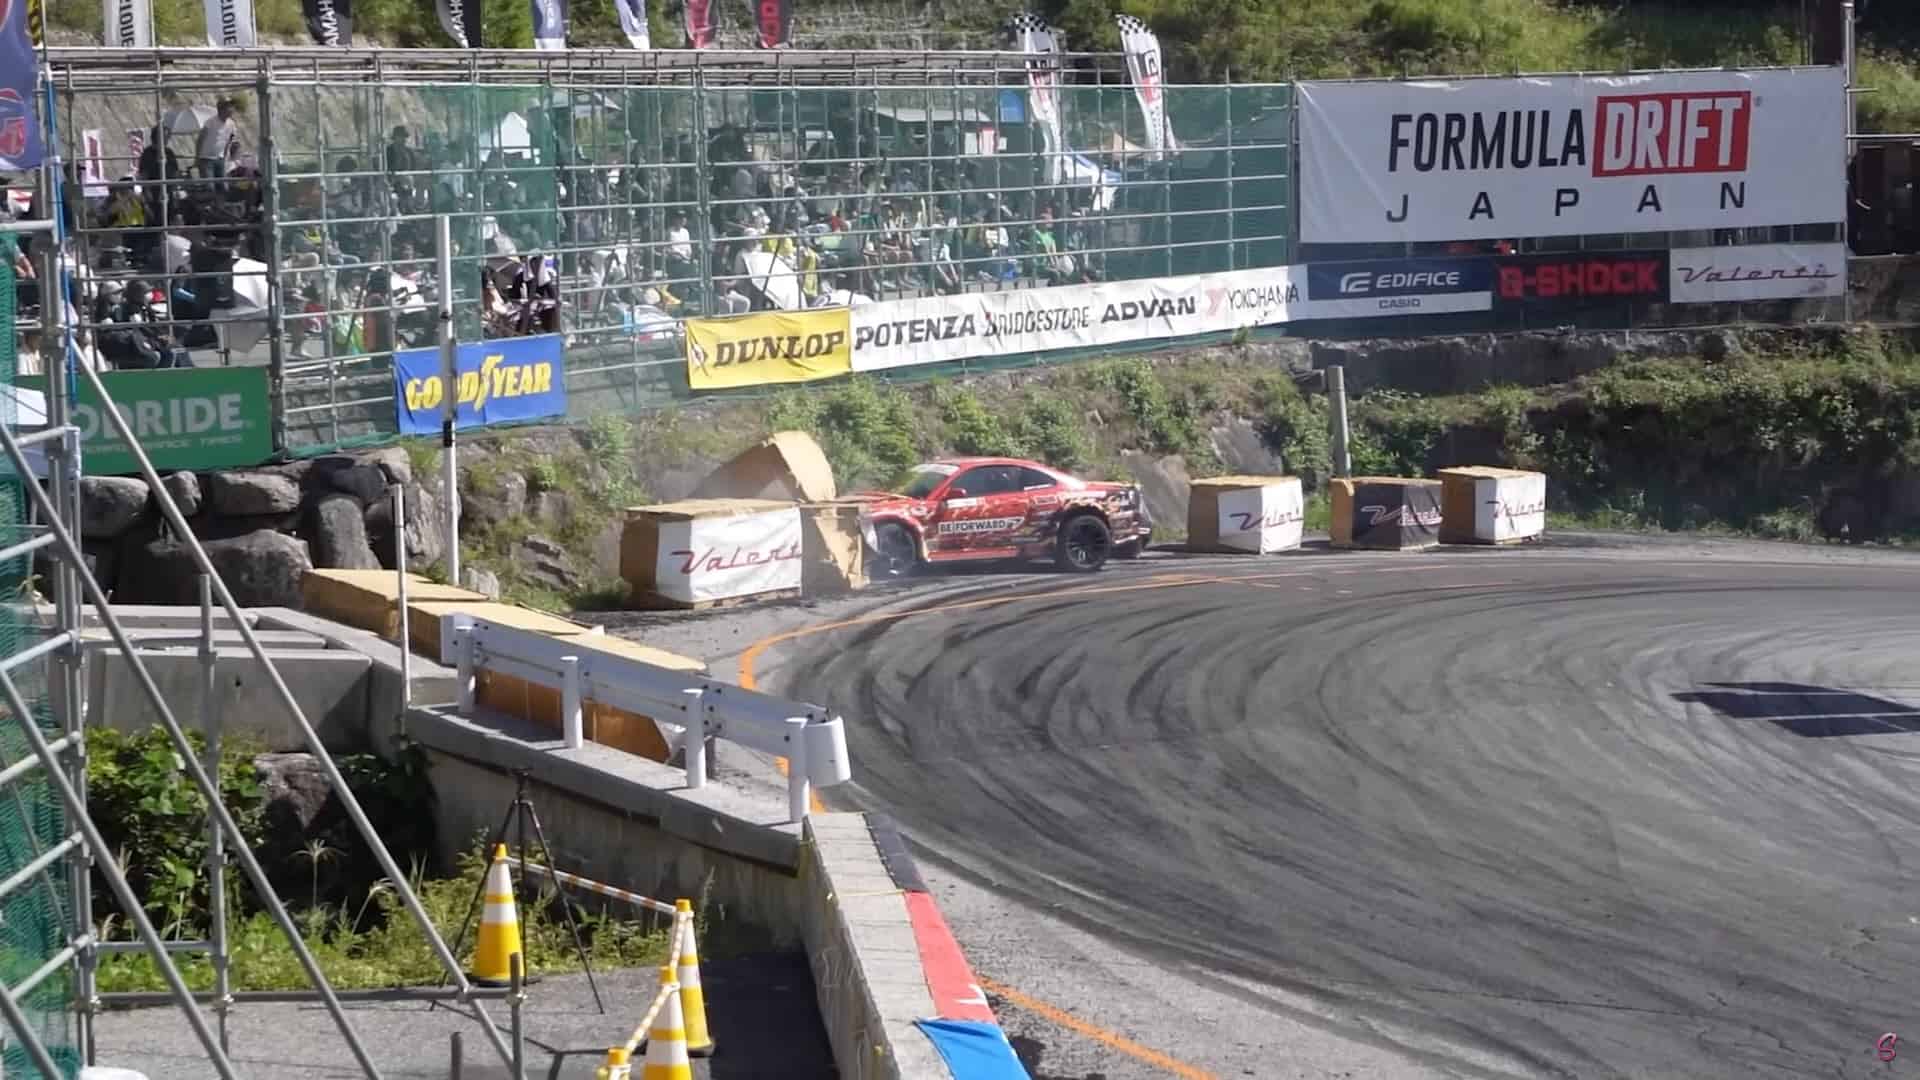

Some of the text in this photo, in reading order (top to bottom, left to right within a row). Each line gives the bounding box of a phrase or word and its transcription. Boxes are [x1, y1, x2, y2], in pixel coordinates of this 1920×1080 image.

[1387, 96, 1744, 172] FORMULA DRIFT
[1386, 181, 1746, 223] JAPAN
[1376, 271, 1460, 289] EDIFICE
[1500, 261, 1663, 298] G-SHOCK
[1677, 263, 1838, 284] Valenti
[1100, 296, 1196, 323] ADVAN
[1226, 284, 1300, 311] YOKOHAMA
[1378, 298, 1421, 310] CASIO
[713, 330, 845, 368] DUNLOP
[854, 313, 976, 350] POTENZA
[405, 354, 552, 411] GODYEAR
